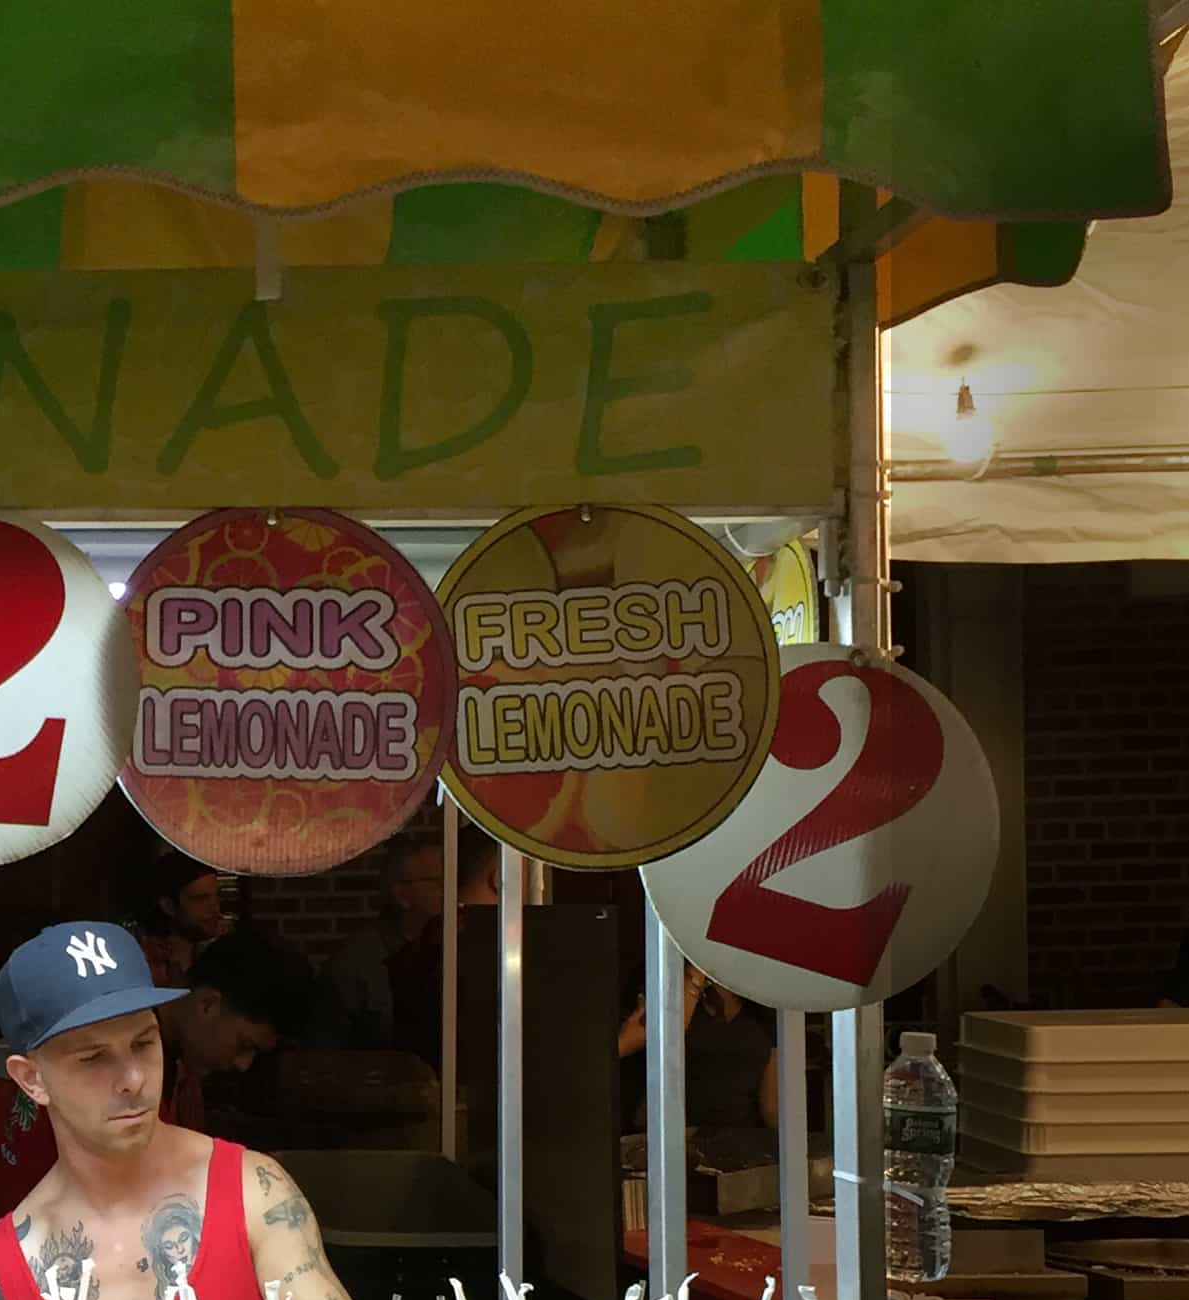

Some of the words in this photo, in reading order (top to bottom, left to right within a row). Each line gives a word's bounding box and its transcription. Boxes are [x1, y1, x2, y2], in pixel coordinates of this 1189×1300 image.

[158, 598, 384, 659] PINK
[462, 585, 722, 662] FRESH
[142, 697, 409, 768] LEMONADE
[465, 683, 738, 764] LEMONADE
[65, 929, 119, 979] NY
